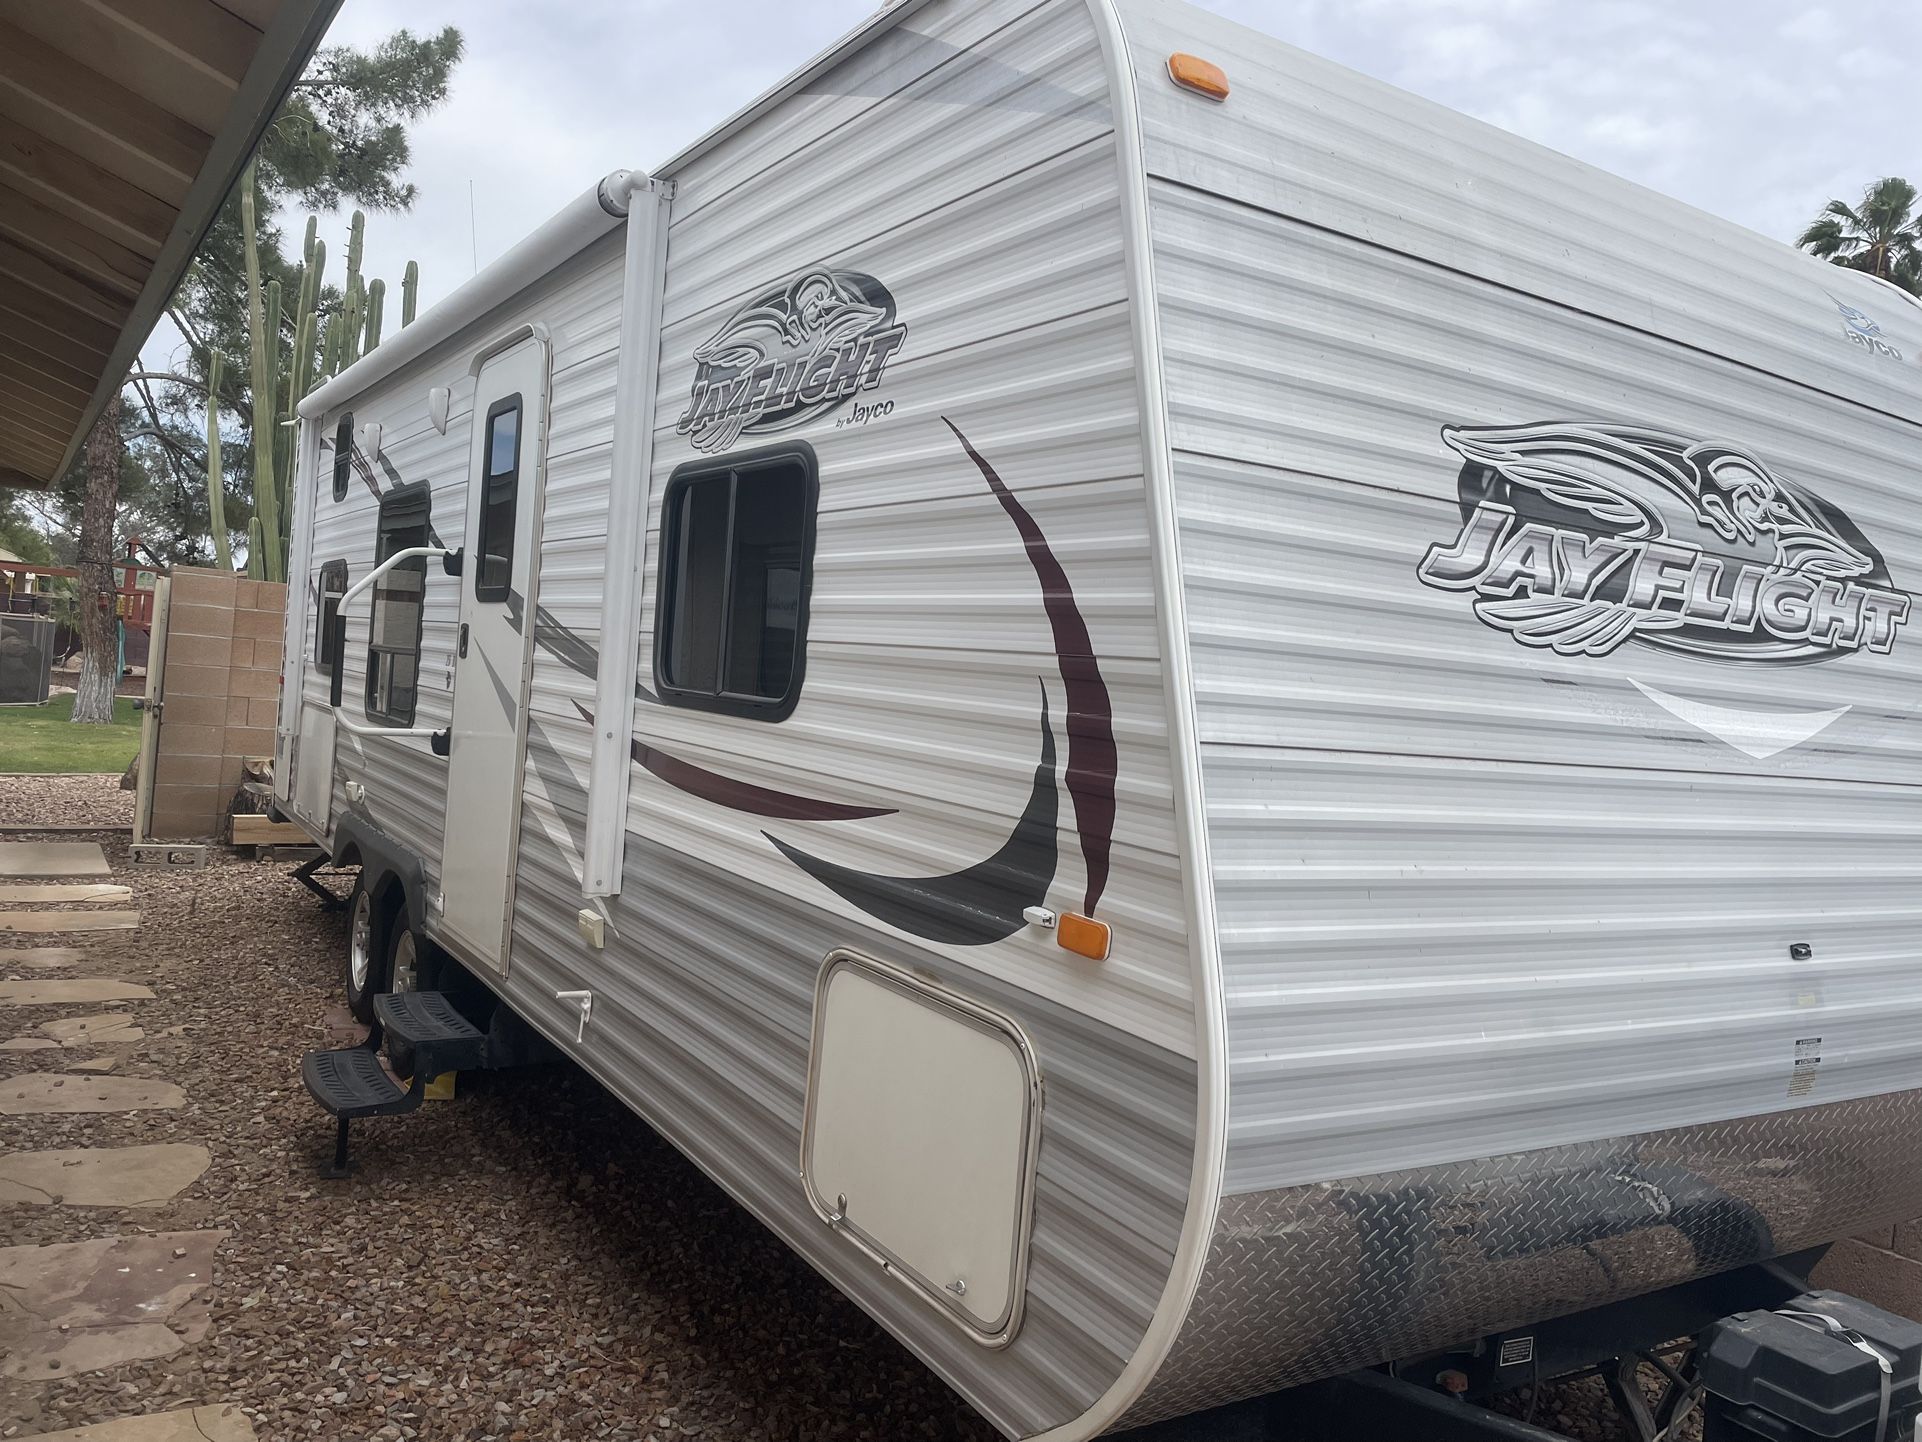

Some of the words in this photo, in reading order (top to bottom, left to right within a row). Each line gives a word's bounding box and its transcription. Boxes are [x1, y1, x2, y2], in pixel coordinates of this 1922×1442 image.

[743, 322, 908, 413] FLIGHT
[835, 417, 846, 429] by
[846, 400, 894, 425] Jayco
[1416, 501, 1637, 600] JAY
[1623, 540, 1912, 655] FLIGHT
